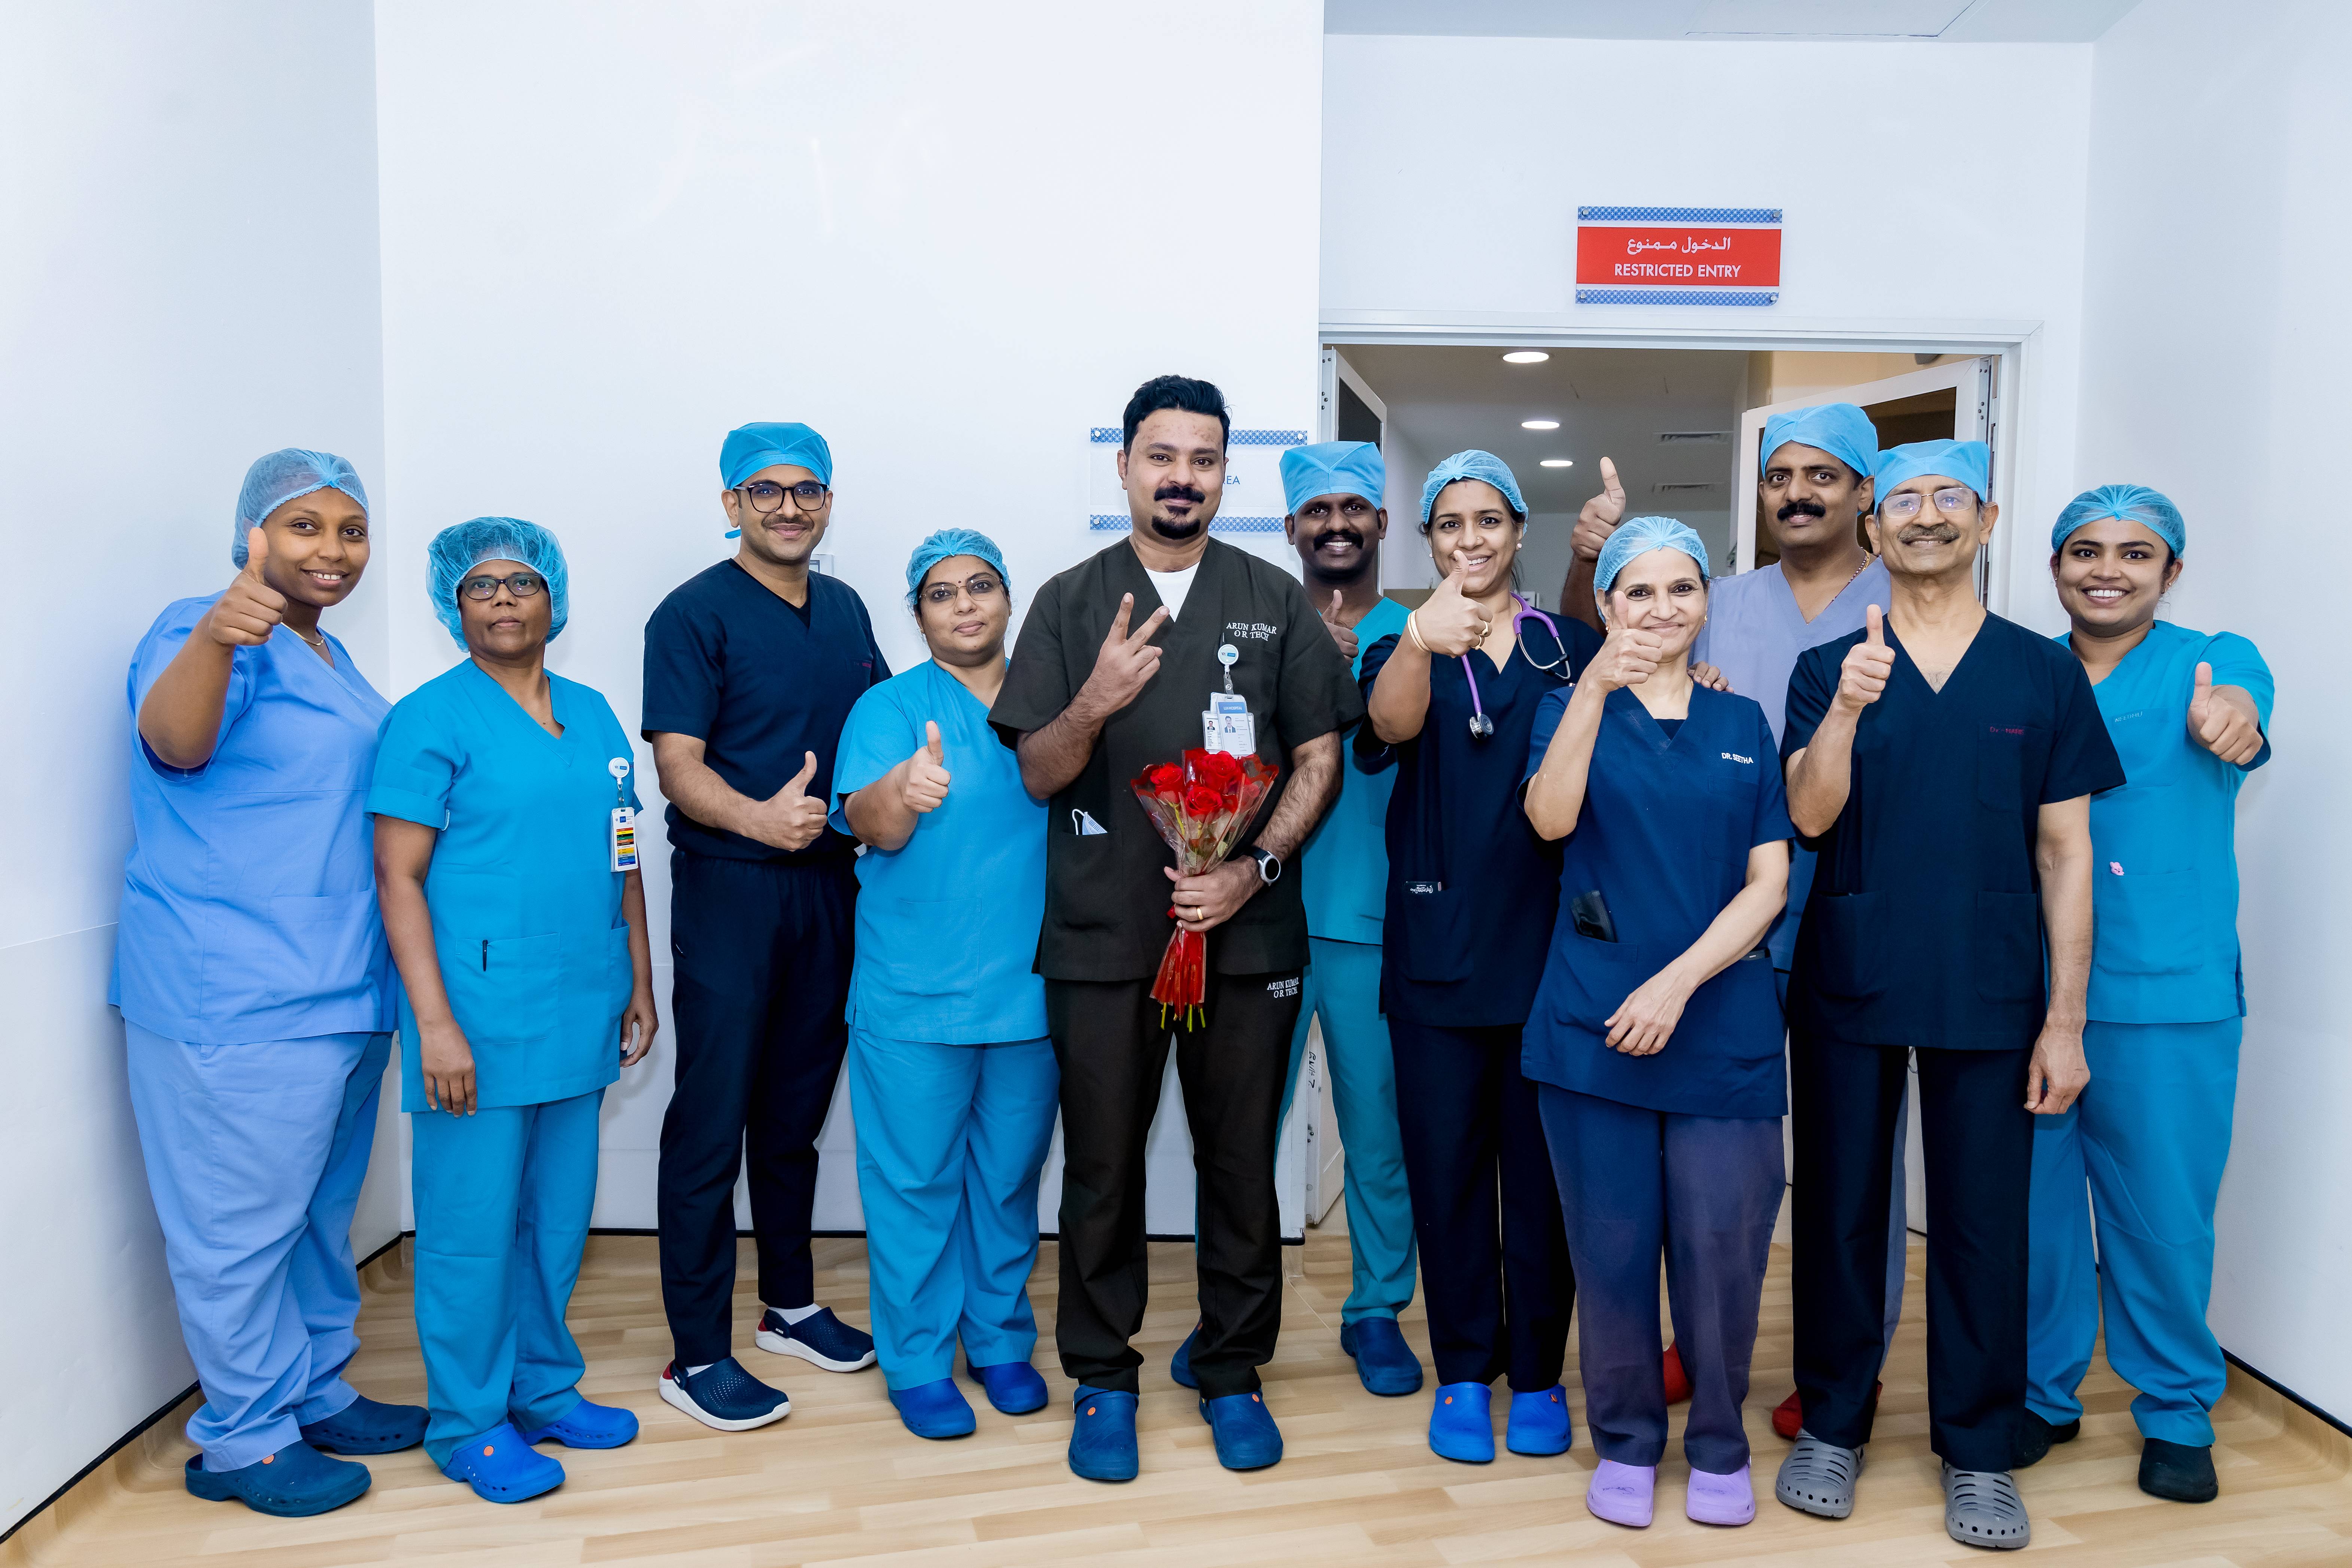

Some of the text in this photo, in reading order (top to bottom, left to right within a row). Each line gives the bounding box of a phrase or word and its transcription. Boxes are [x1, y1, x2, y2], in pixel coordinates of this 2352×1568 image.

[1627, 236, 1731, 255] الدخول ممنوع
[1614, 263, 1742, 278] RESTRICTED ENTRY
[1224, 475, 1240, 484] EA
[1226, 622, 1277, 635] ARUN KUMAR
[1249, 631, 1270, 641] TECH
[1732, 753, 1754, 764] SEETHA
[1267, 981, 1284, 990] ARUN
[1285, 987, 1298, 996] TECH
